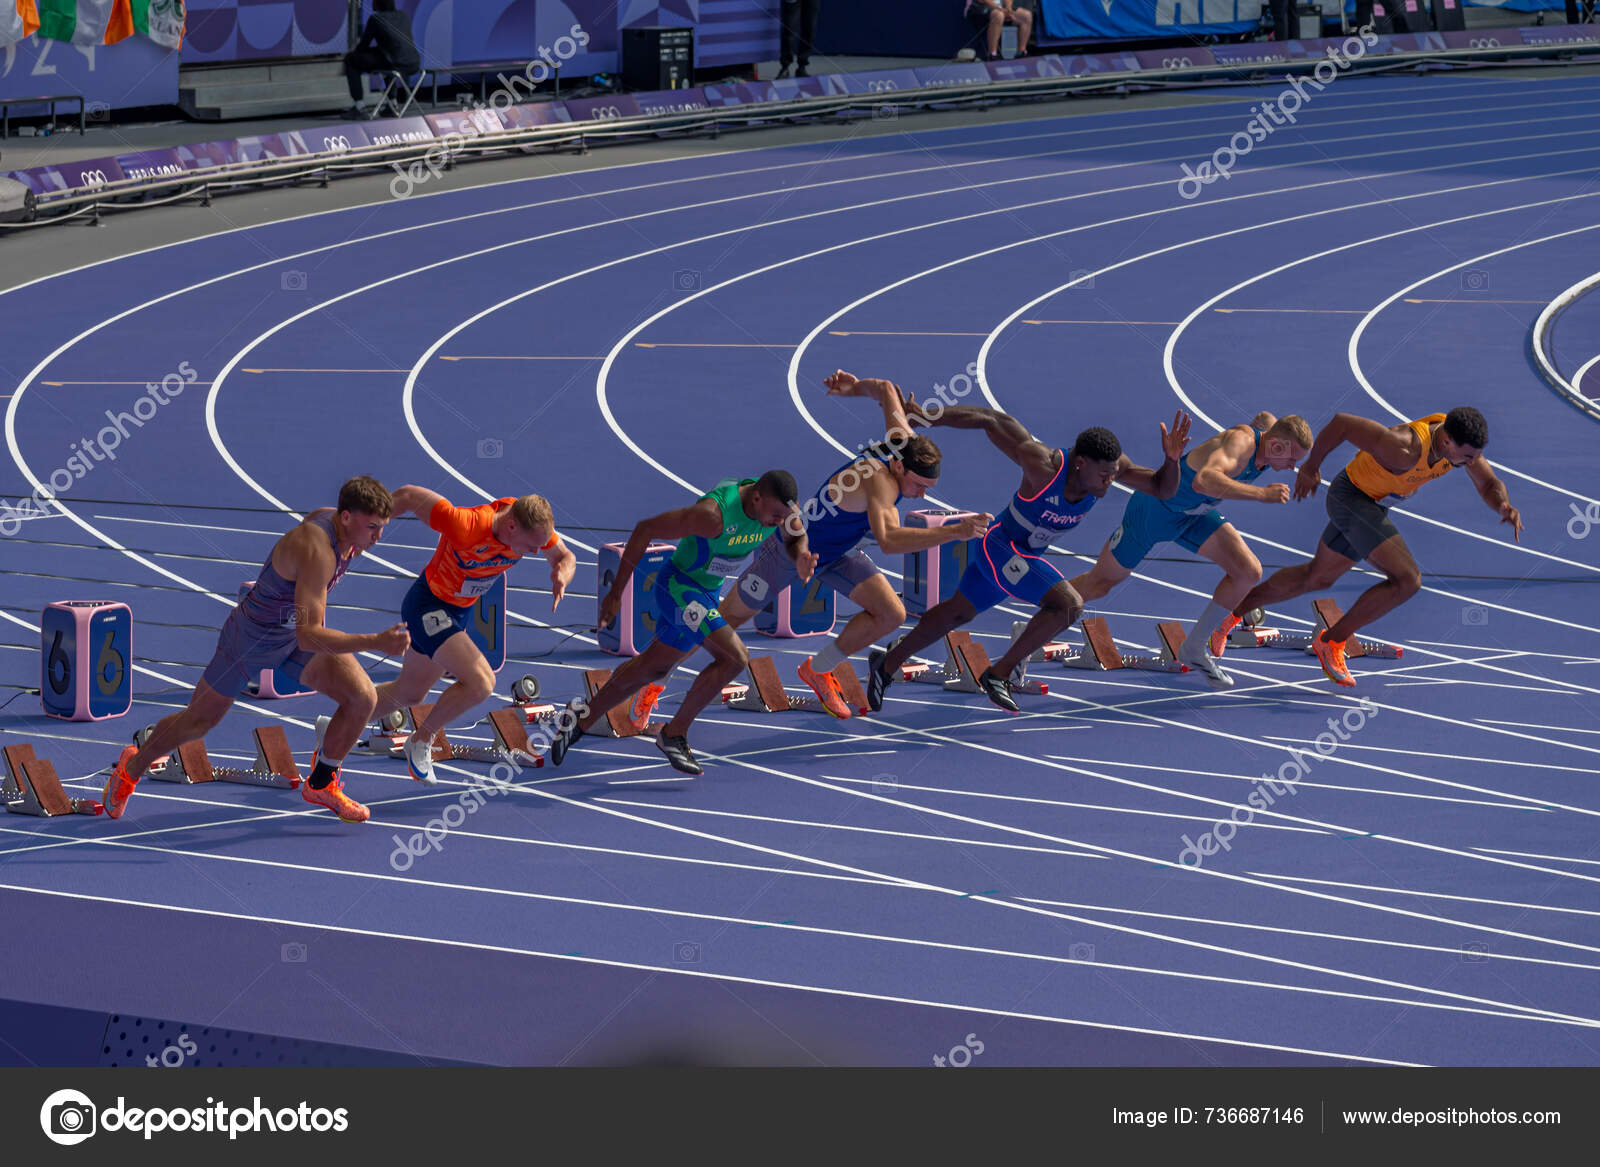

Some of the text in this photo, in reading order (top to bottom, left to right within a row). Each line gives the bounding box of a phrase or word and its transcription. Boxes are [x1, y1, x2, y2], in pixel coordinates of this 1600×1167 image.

[728, 532, 763, 546] BRASIL
[750, 580, 760, 593] 5
[48, 630, 71, 695] 6
[97, 631, 124, 696] 6
